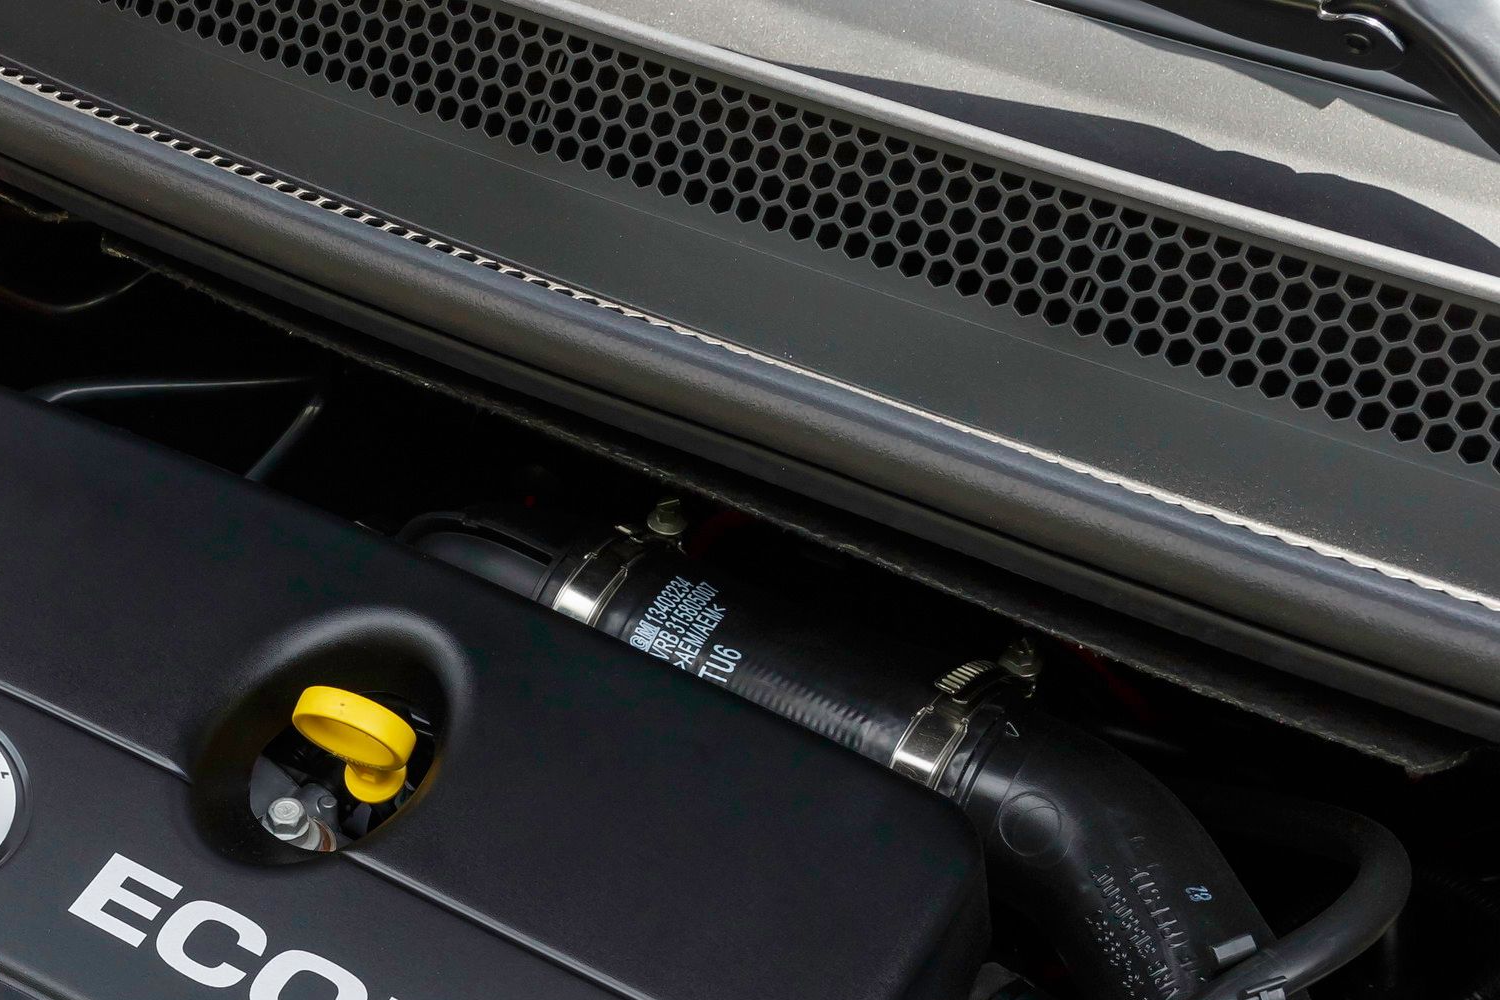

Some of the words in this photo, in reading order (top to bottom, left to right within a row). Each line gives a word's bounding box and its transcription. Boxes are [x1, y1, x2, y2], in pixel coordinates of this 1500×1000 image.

[629, 620, 660, 652] GM
[645, 575, 694, 625] 13403234
[649, 630, 679, 660] VRB
[665, 581, 719, 634] 315805007
[698, 644, 742, 682] TU6
